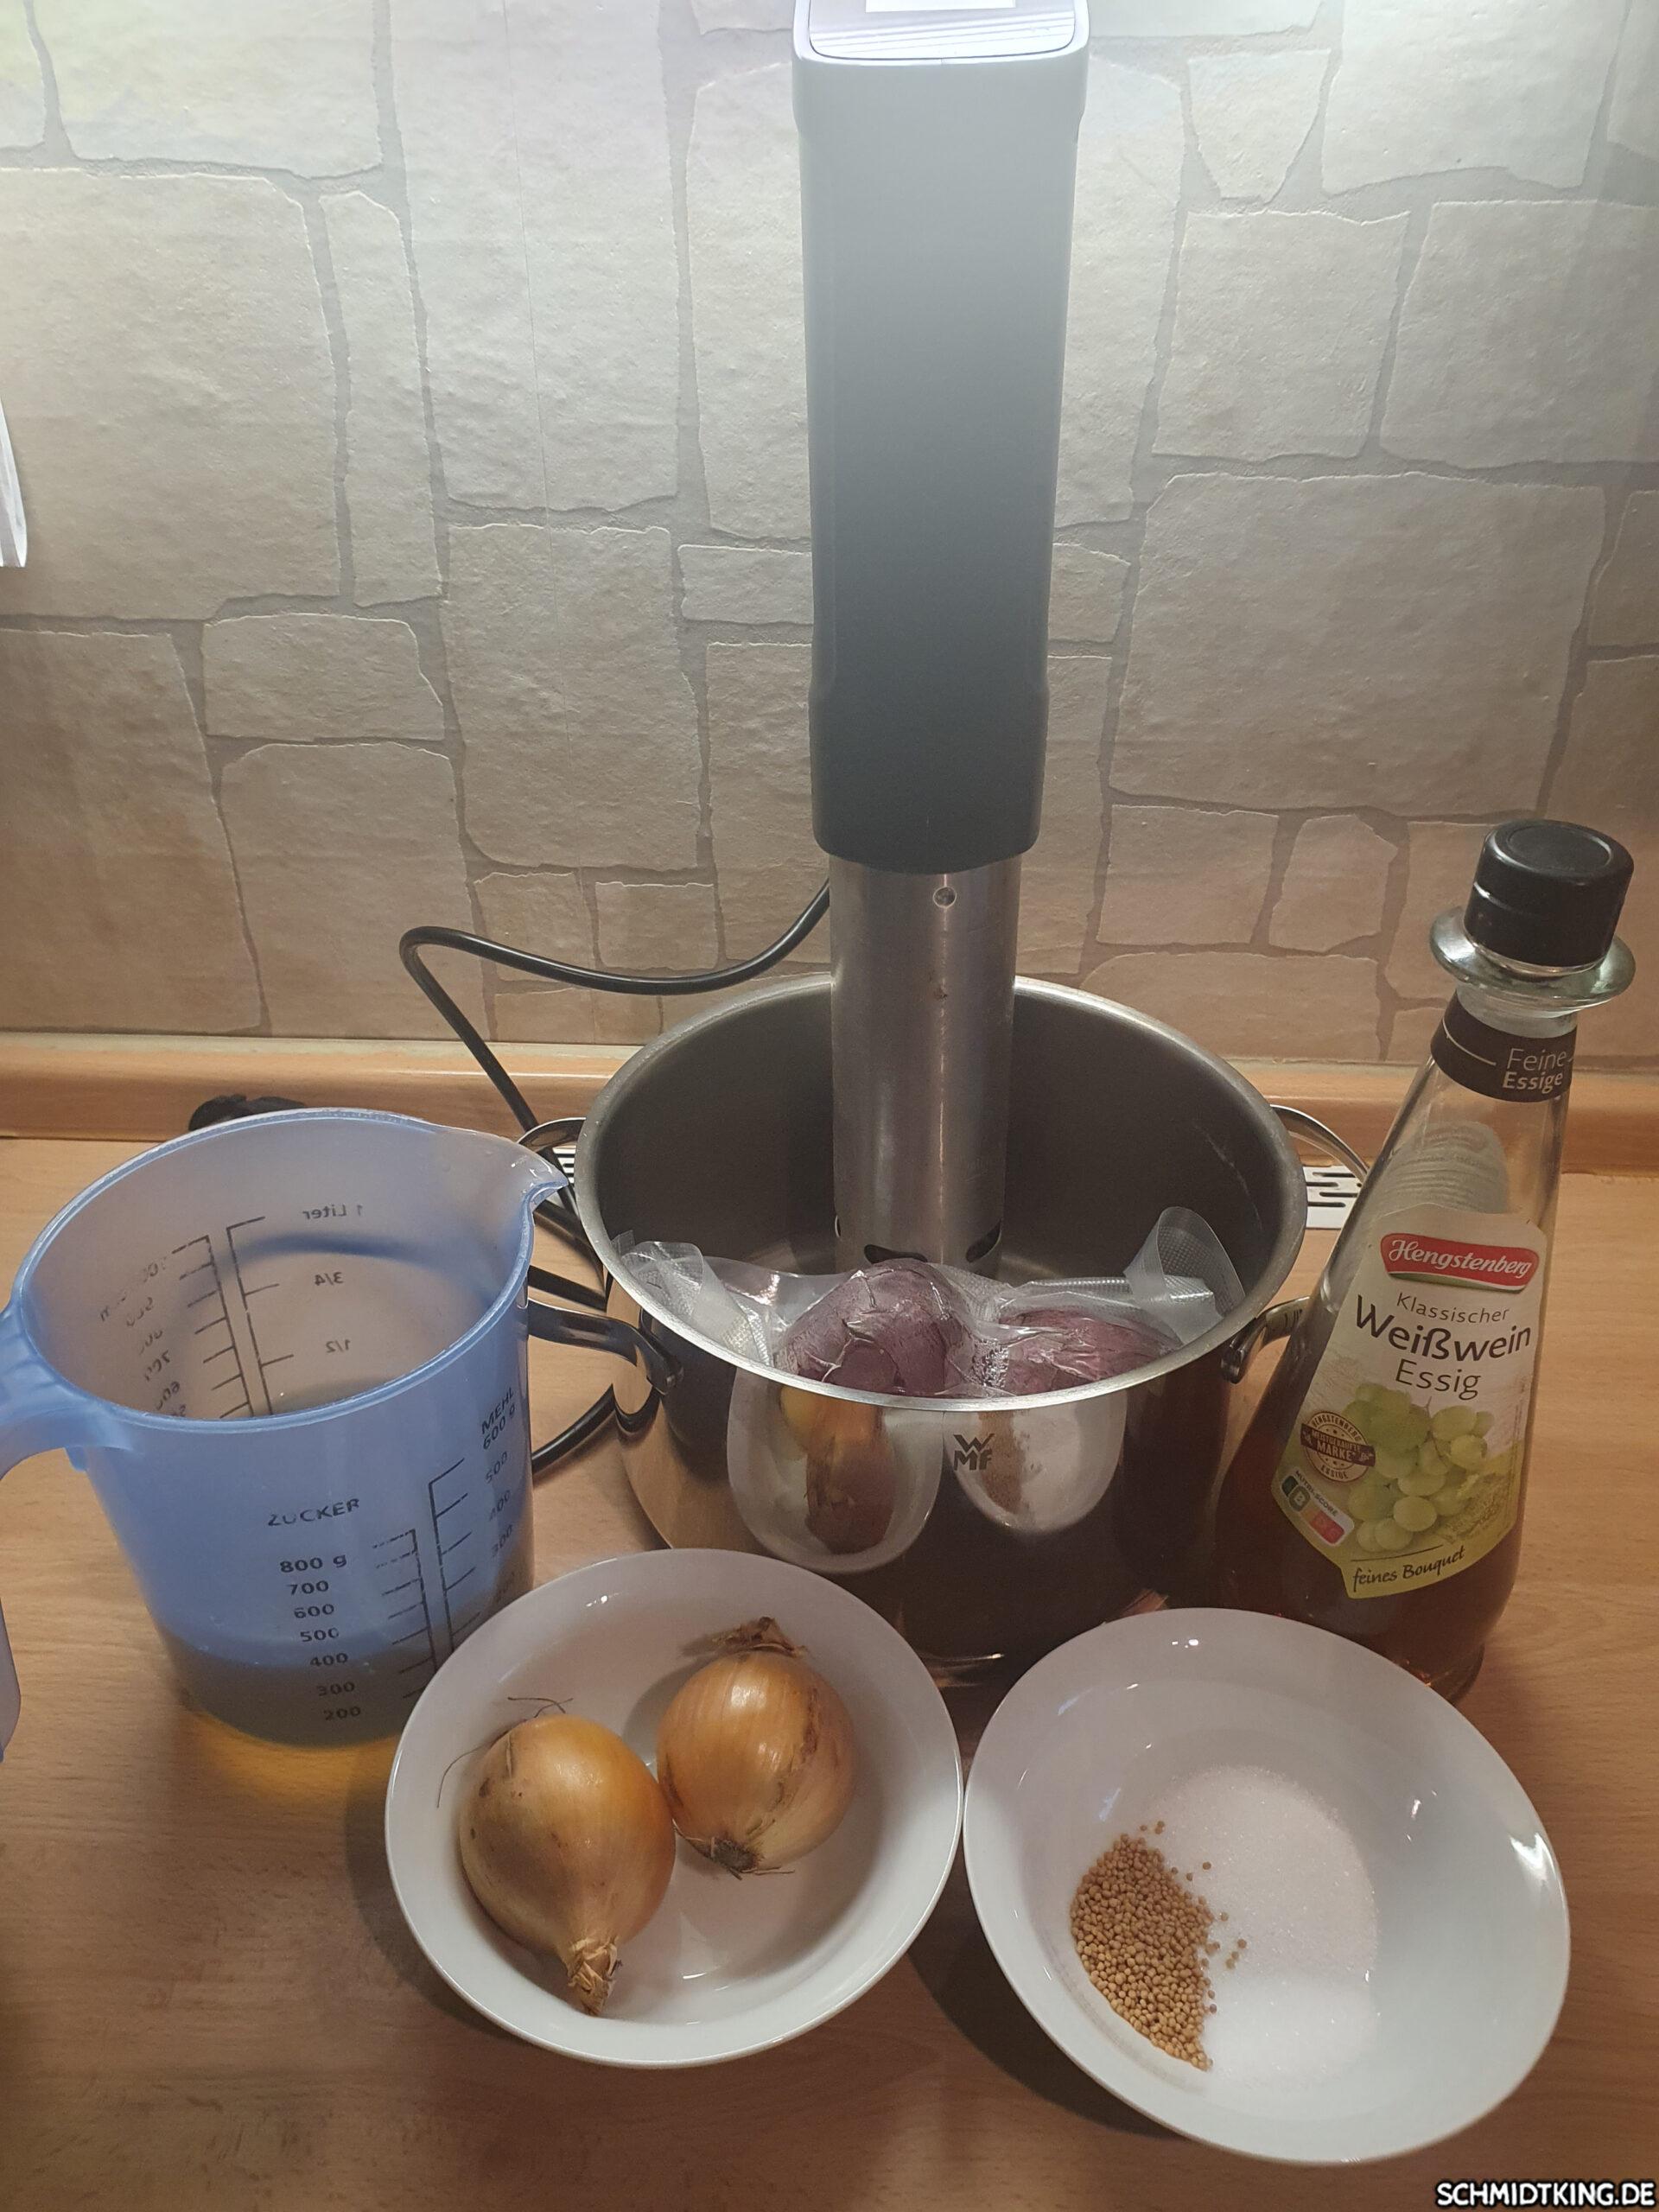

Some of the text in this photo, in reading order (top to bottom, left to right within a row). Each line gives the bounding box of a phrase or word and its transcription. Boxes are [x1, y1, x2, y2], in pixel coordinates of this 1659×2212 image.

[1506, 1047, 1567, 1071] Feine
[1502, 1071, 1563, 1095] Essige
[1388, 1238, 1533, 1279] Hengstenberg
[1396, 1292, 1510, 1324] Klassischer
[1355, 1294, 1532, 1363] Weißwein
[1395, 1358, 1482, 1401] Essig
[481, 1386, 515, 1434] MEHL
[482, 1415, 506, 1451] 600
[267, 1497, 360, 1527] ZUCKER
[279, 1554, 347, 1573] 800 g
[1351, 1545, 1466, 1595] feines Bouquet
[289, 1580, 329, 1596] 700
[294, 1603, 335, 1618] 600
[300, 1626, 340, 1642] 500
[309, 1652, 349, 1668] 400
[316, 1681, 356, 1697] 300
[323, 1706, 362, 1721] 200
